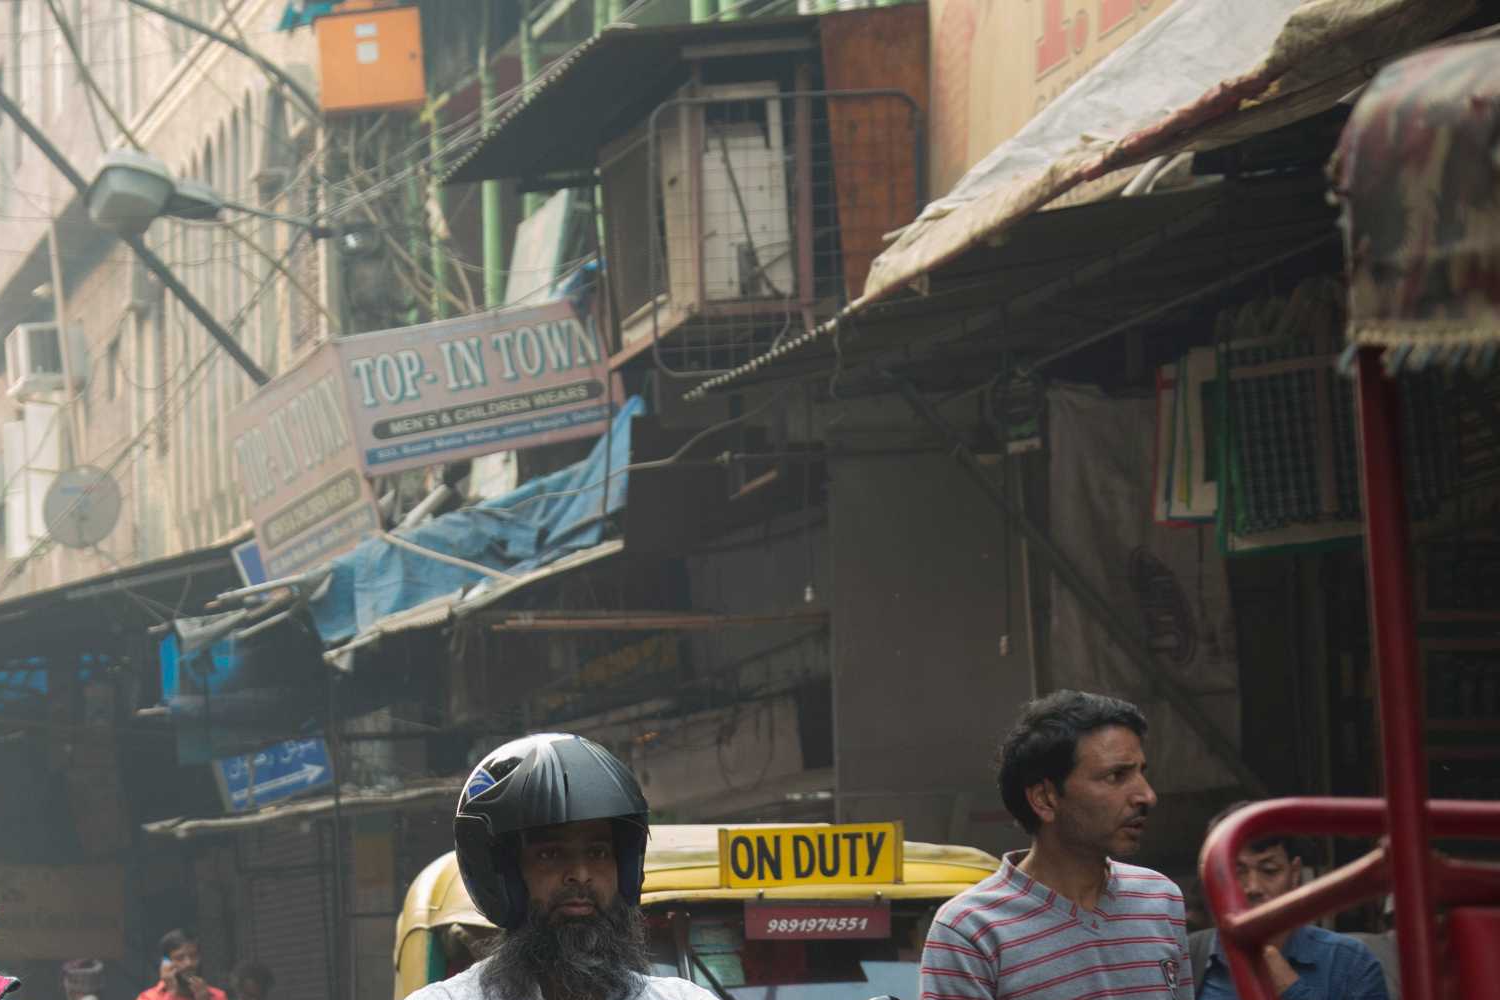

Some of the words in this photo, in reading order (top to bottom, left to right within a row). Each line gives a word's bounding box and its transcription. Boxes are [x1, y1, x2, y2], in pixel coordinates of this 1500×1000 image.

[495, 316, 600, 381] TOWN
[388, 411, 437, 437] MEN'S
[440, 407, 453, 425] &
[454, 396, 532, 424] CHILDREN
[533, 383, 590, 408] WEARS
[729, 834, 783, 881] ON
[792, 831, 888, 879] DUTY
[766, 917, 868, 934] 9891974551
